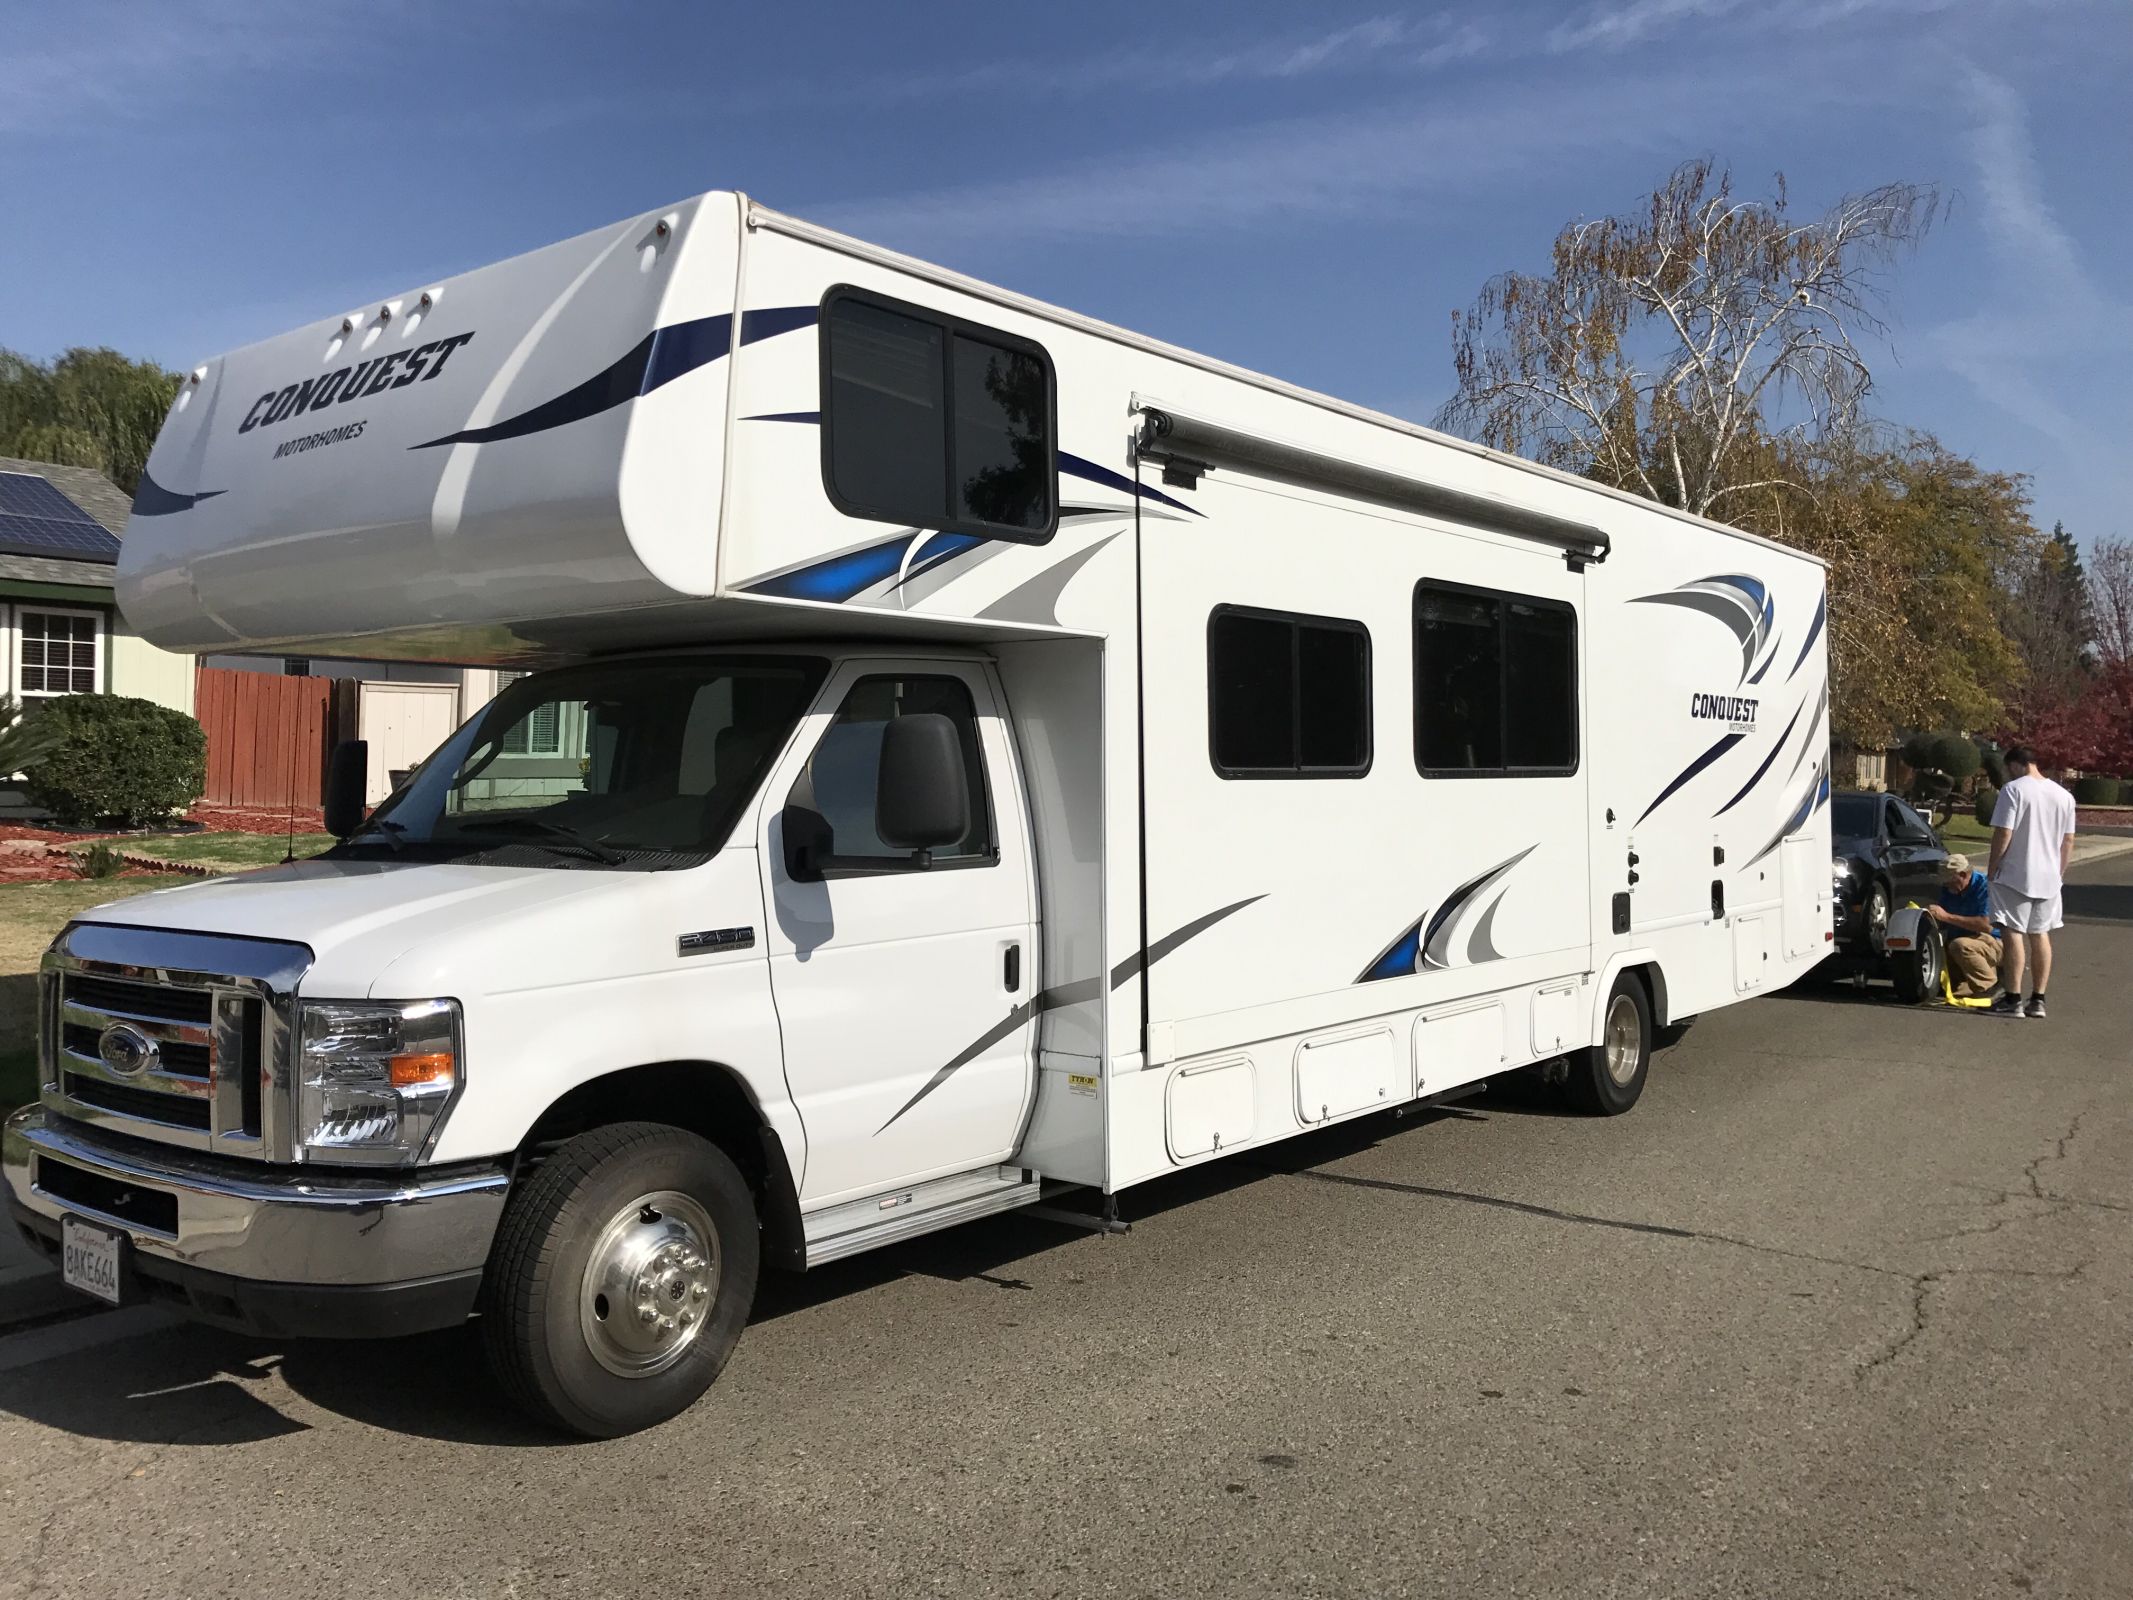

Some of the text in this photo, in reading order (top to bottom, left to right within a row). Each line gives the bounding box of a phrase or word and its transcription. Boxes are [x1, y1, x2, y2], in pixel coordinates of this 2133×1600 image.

[238, 331, 476, 434] CONQUEST
[272, 420, 368, 460] MOTORHOMES
[1691, 692, 1759, 723] CONQUEST
[65, 1244, 116, 1290] 8AKE664
